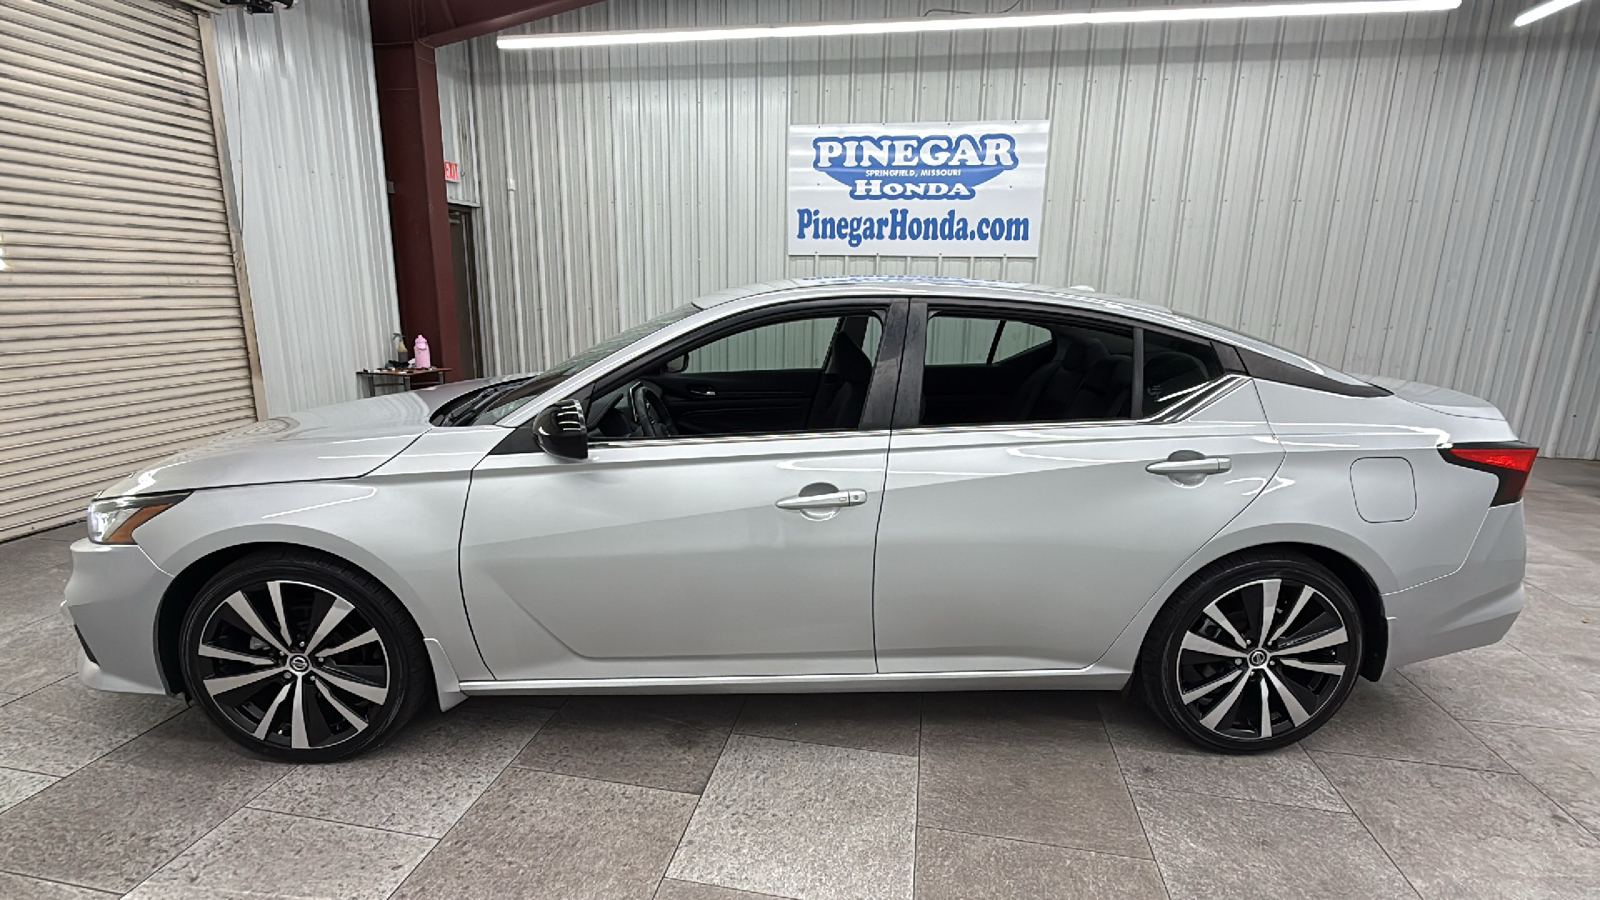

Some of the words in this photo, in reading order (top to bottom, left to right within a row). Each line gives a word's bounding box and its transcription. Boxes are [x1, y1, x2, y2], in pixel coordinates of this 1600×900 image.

[816, 138, 1015, 168] PINEGAR
[865, 169, 918, 178] SPRINGFIELD,
[920, 169, 961, 177] MISSOURI
[853, 179, 971, 196] HONDA
[796, 208, 1029, 247] PinegarHonda.com
